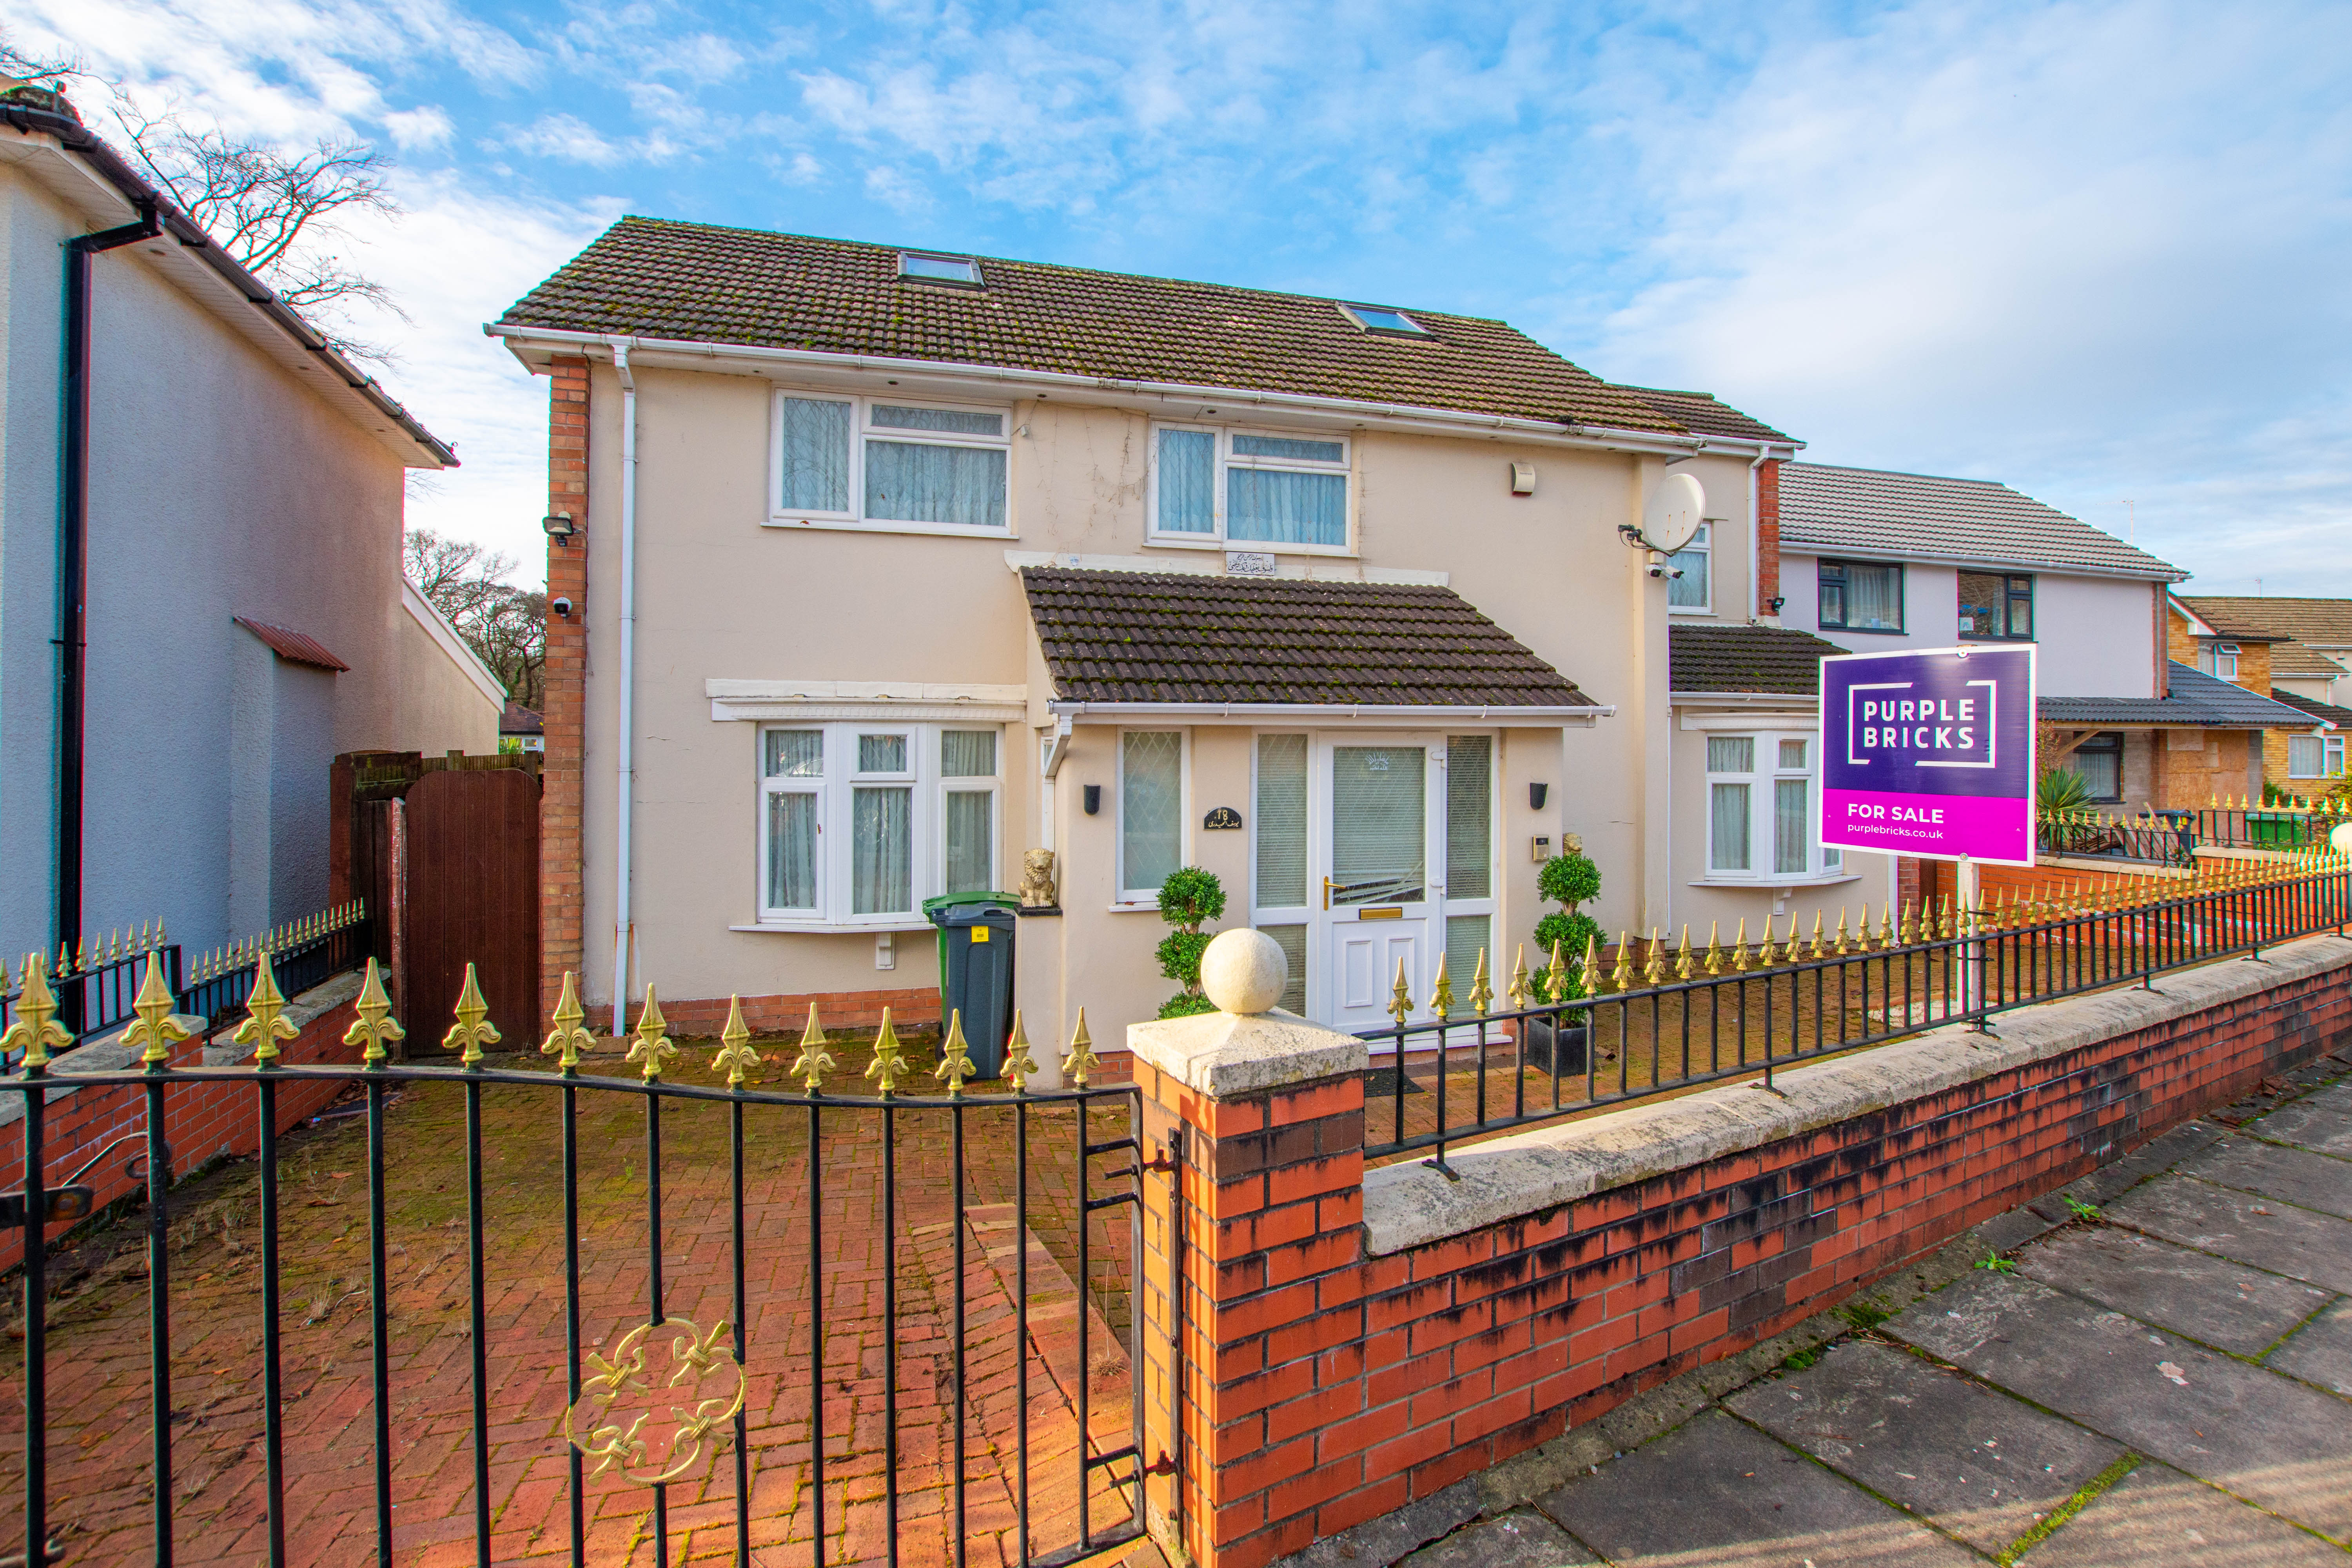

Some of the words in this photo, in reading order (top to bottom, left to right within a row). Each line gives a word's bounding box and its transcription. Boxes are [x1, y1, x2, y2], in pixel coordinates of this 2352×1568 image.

[1864, 699, 1975, 721] PURPLE
[1864, 727, 1975, 748] BRICKS
[1217, 809, 1228, 820] 18
[1848, 803, 1885, 819] FOR
[1891, 806, 1944, 824] SALE
[1847, 824, 1944, 839] purplebricks.co.uk
